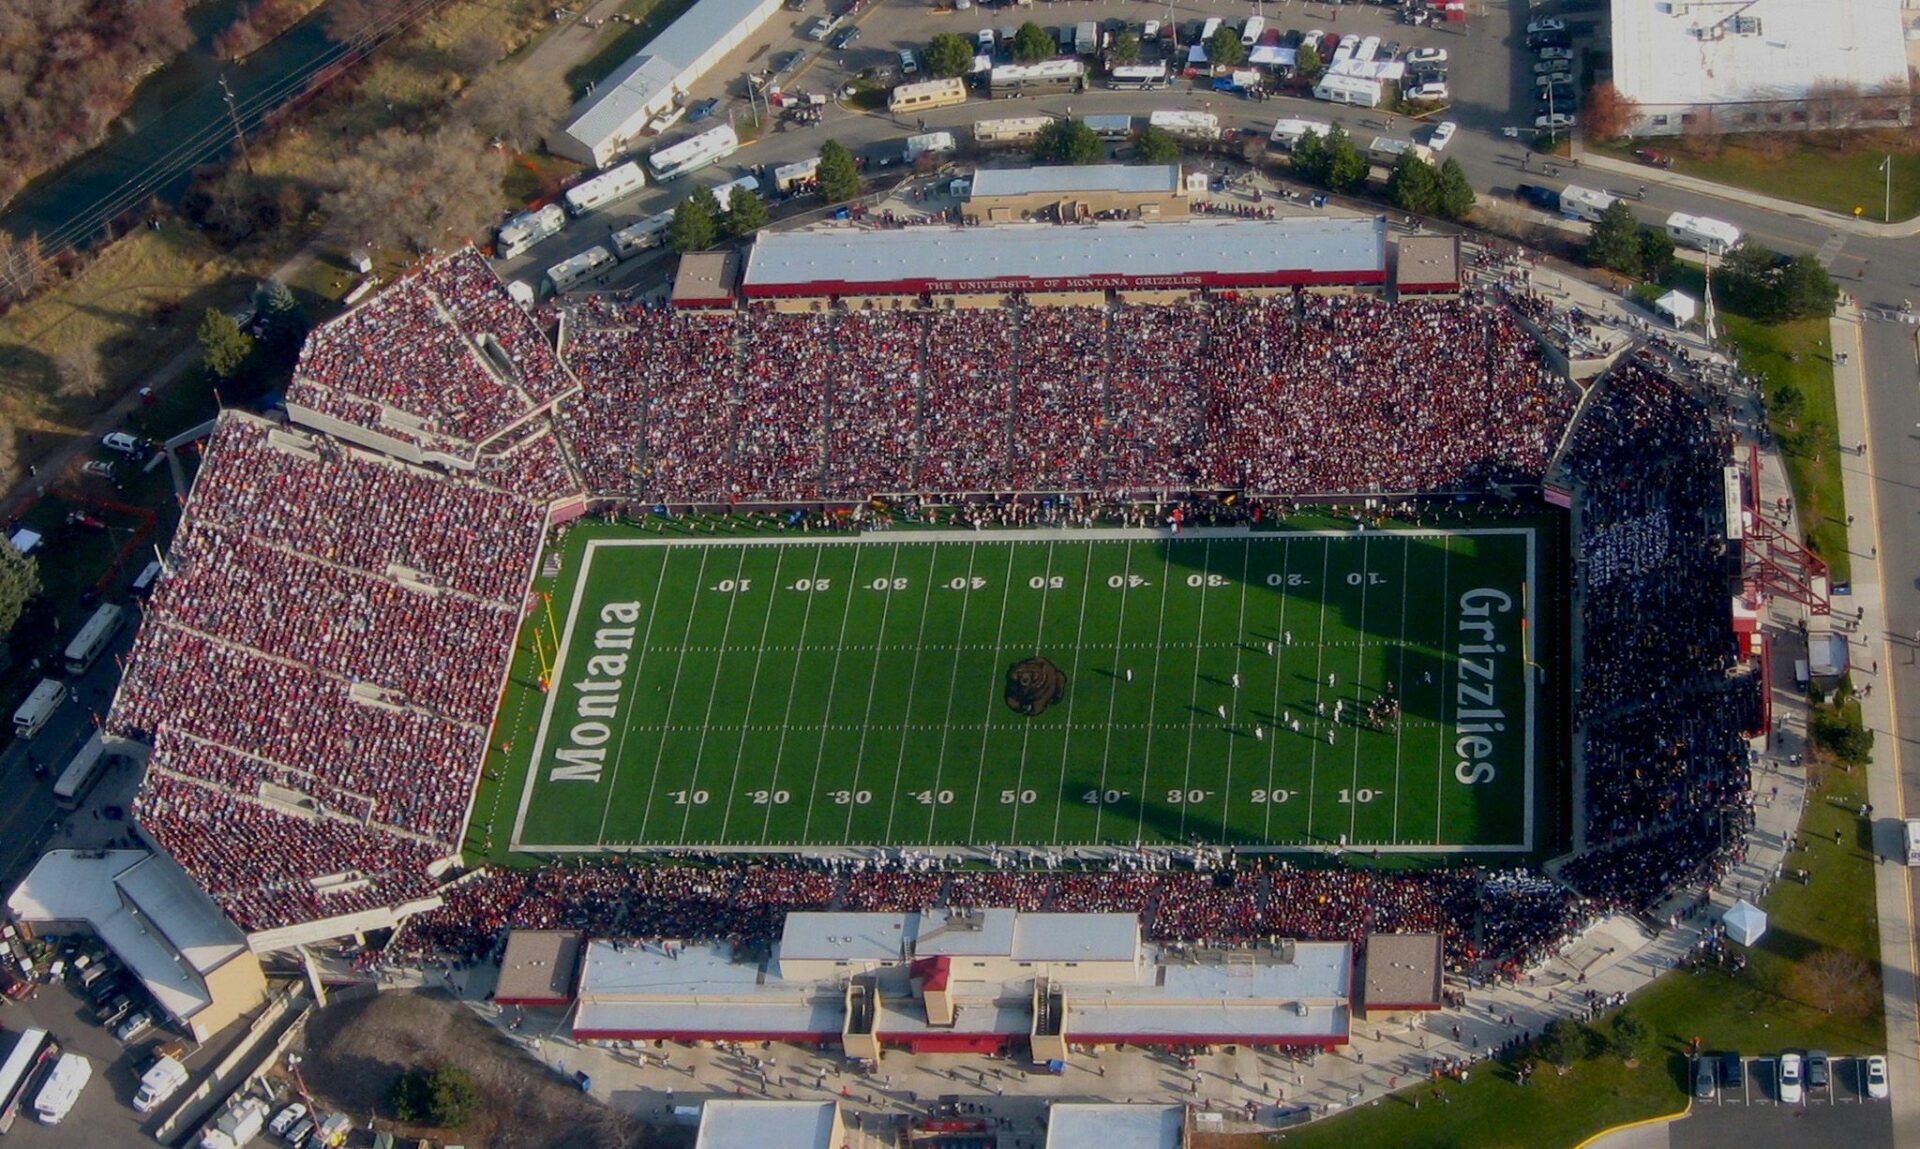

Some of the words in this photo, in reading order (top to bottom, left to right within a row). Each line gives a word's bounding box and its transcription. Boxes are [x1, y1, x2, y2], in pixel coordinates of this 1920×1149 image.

[925, 281, 953, 291] THE
[958, 279, 1037, 290] UNIVERSITY
[1043, 279, 1060, 288] OF
[1066, 277, 1129, 287] MONTANA
[1135, 276, 1203, 286] GRIZZLIES
[549, 600, 641, 783] Montana
[1455, 587, 1512, 786] Grizzlies
[673, 790, 709, 804] 10
[753, 790, 790, 804] 20
[834, 790, 872, 804] 30
[915, 790, 954, 804] 40
[1000, 790, 1037, 804] 50
[1081, 790, 1120, 804] 40
[1166, 790, 1205, 803] 30
[1250, 789, 1288, 803] 20
[1338, 789, 1374, 803] 10
